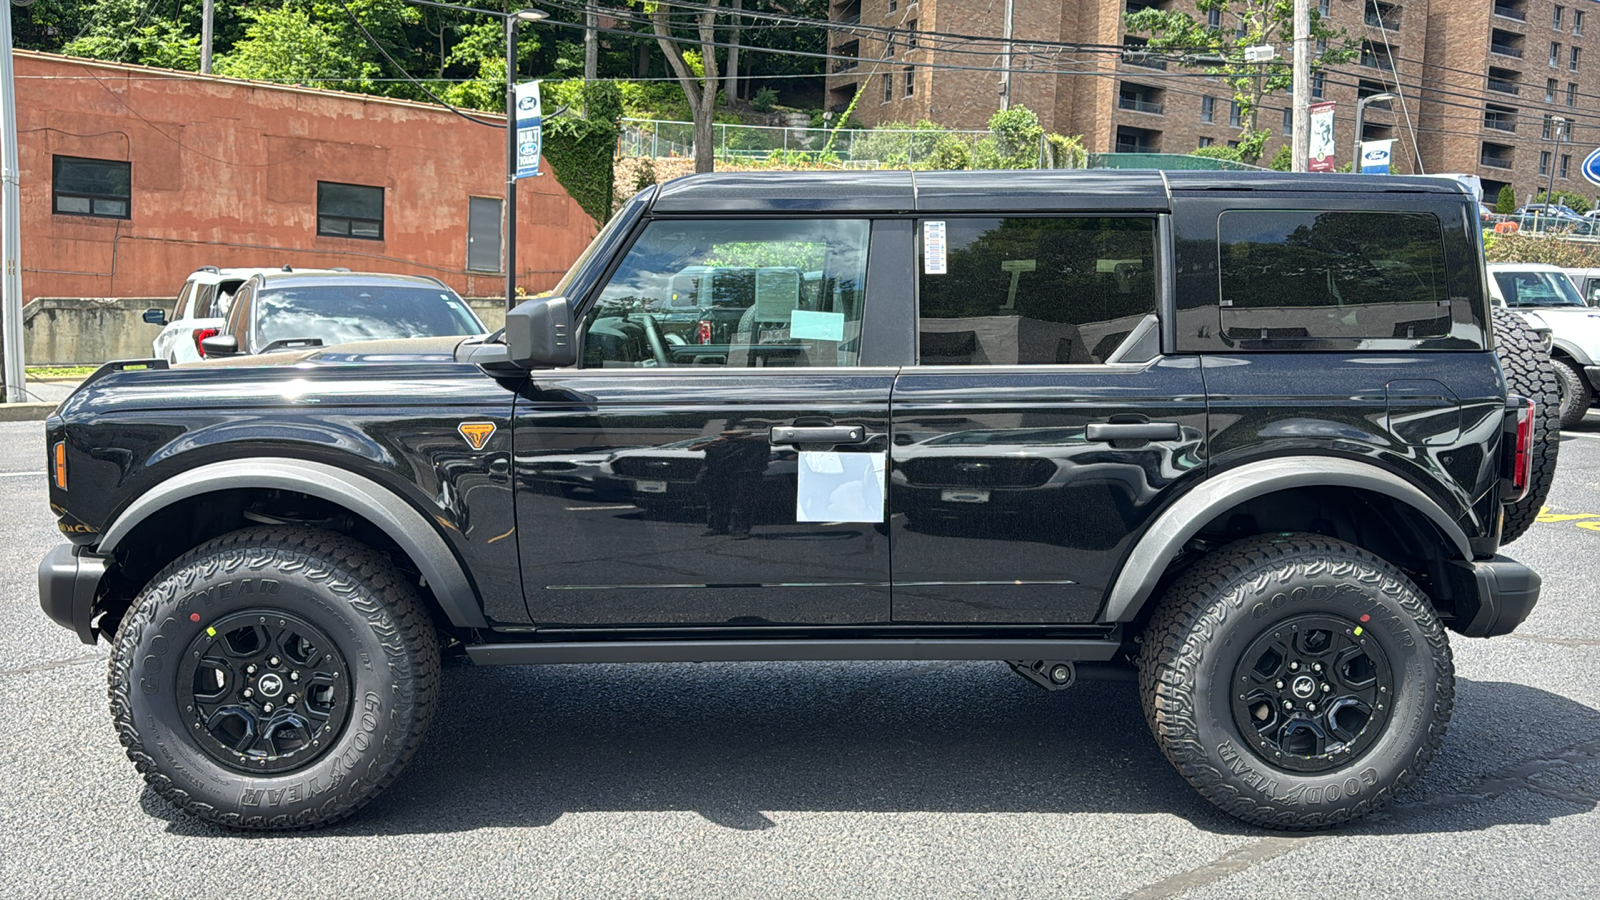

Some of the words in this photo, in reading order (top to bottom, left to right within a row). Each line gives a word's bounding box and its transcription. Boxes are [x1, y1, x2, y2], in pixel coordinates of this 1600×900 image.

[520, 97, 536, 110] Ford
[519, 130, 538, 144] BUILT
[1367, 150, 1387, 160] Ford
